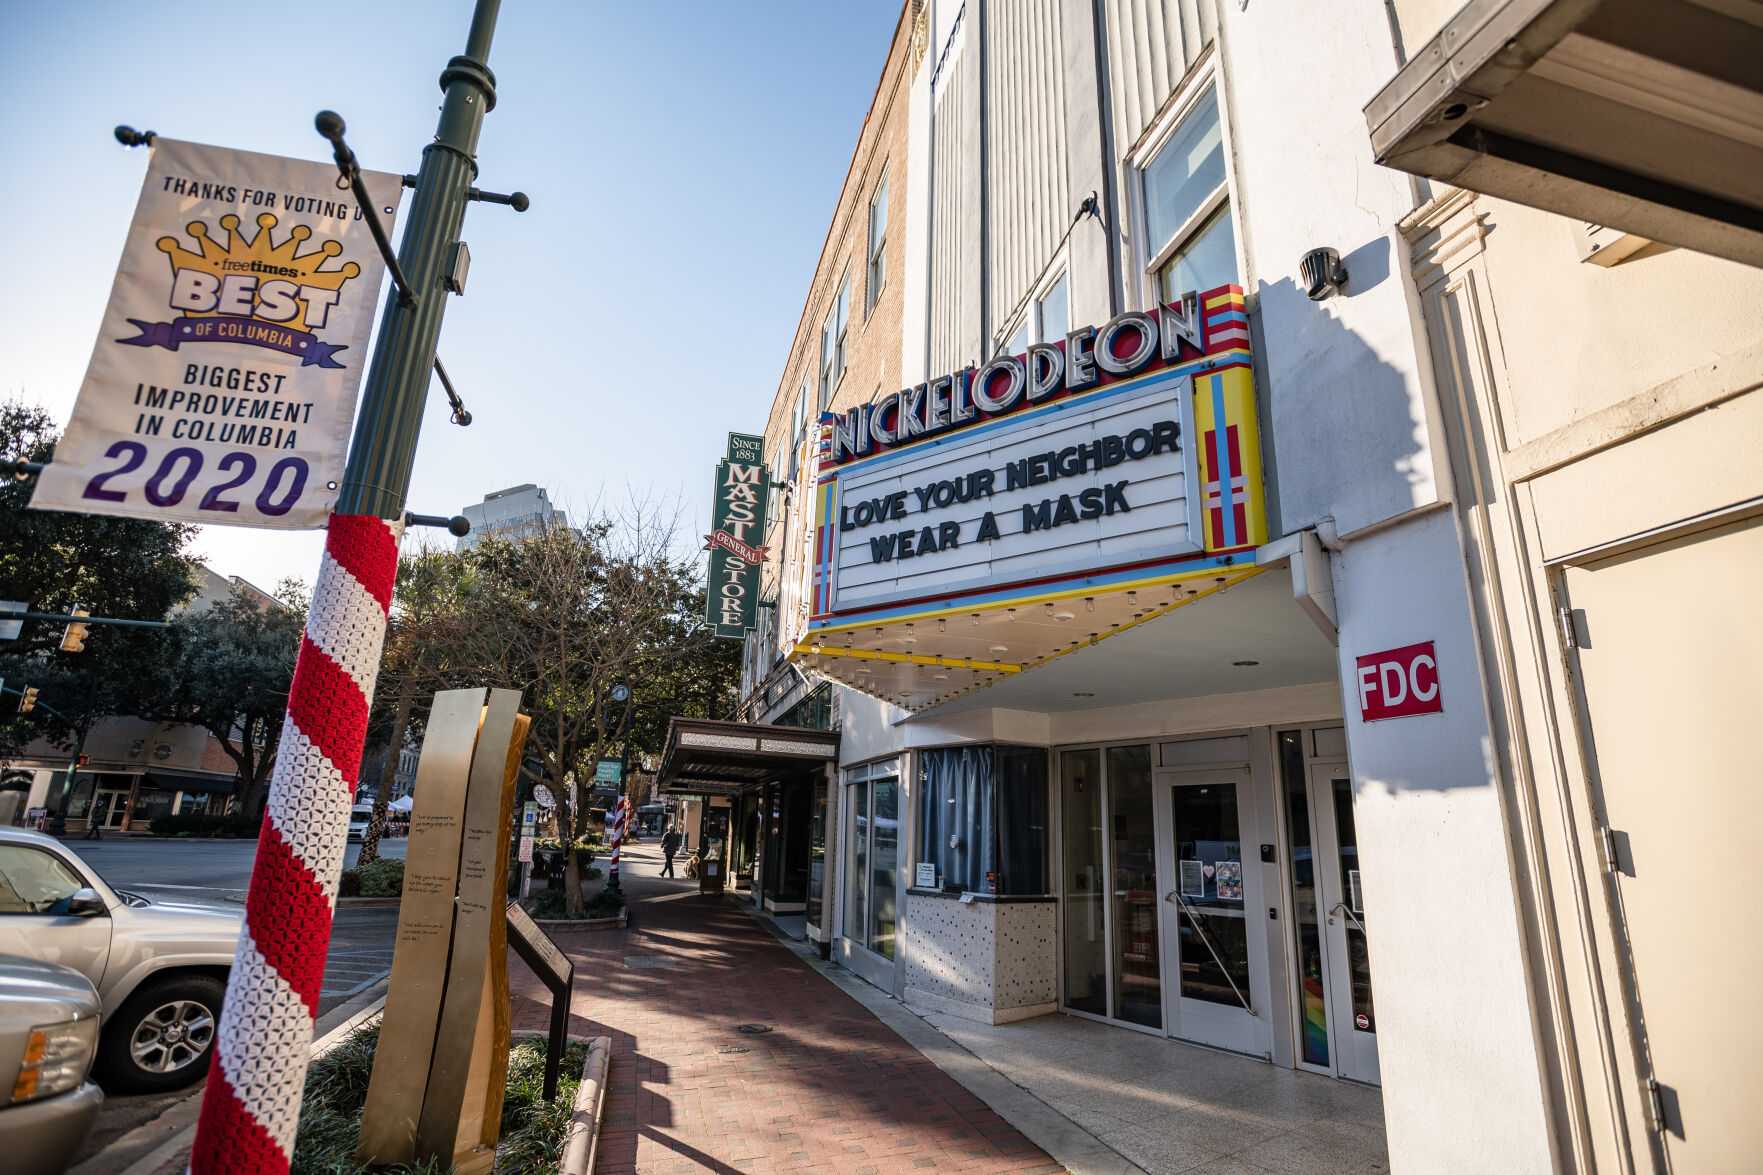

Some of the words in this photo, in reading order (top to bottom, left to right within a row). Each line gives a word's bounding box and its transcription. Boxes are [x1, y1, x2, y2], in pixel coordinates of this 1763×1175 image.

[163, 176, 236, 204] THANKS
[242, 188, 276, 208] FOR
[284, 194, 347, 220] VOTING
[169, 267, 340, 330] BEST
[196, 323, 213, 336] OF
[218, 322, 292, 348] COLUMBIA
[134, 383, 314, 424] IMPROVEMENT
[184, 364, 286, 394] BIGGEST
[831, 290, 1206, 463] NICKELODEON
[134, 413, 164, 436] IN
[172, 418, 297, 449] COLUMBIA
[735, 450, 755, 462] 1883
[82, 440, 309, 516] 2020
[723, 462, 763, 542] MAST
[839, 491, 908, 532] LOVE
[913, 468, 995, 513] YOUR
[1006, 420, 1181, 492] NEIGHBOR
[716, 532, 757, 563] GENERAL
[869, 519, 960, 564] WEAR
[975, 511, 1000, 544] A
[1022, 479, 1132, 534] MASK
[720, 556, 747, 627] STORE
[1358, 654, 1439, 711] FDC
